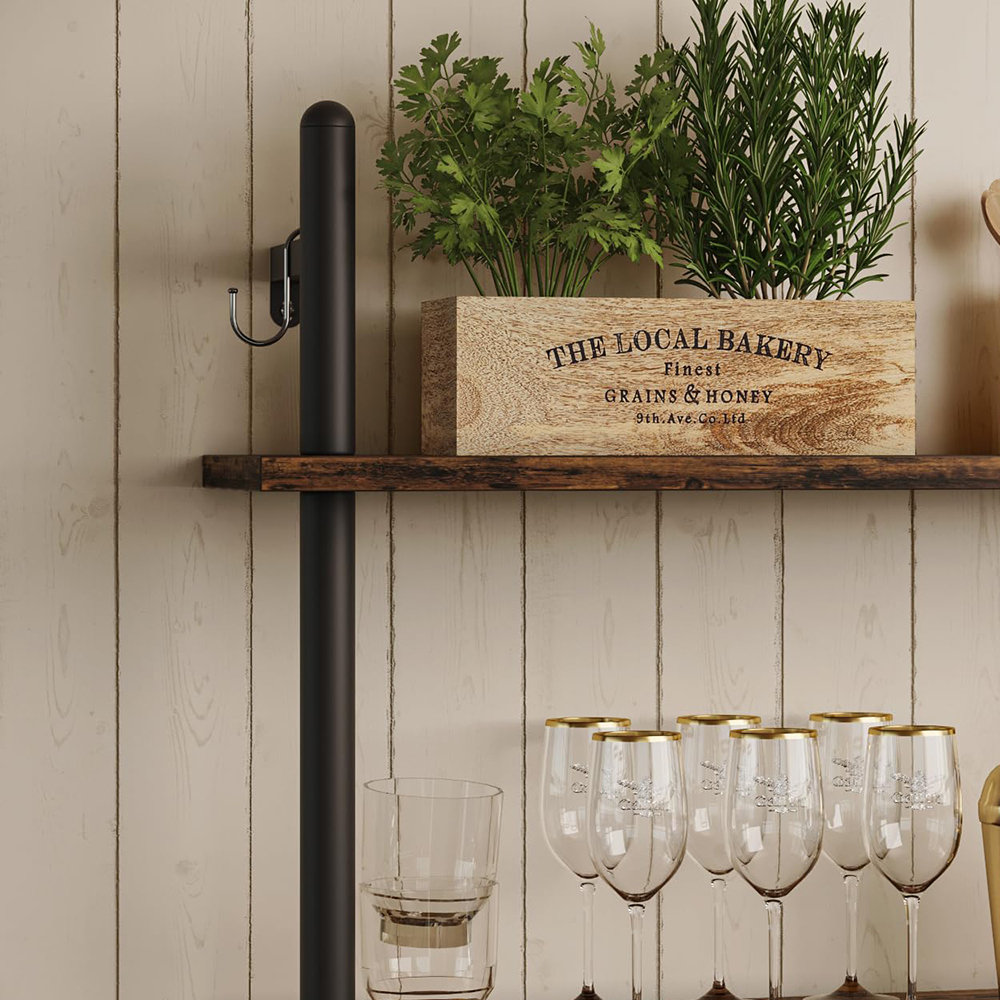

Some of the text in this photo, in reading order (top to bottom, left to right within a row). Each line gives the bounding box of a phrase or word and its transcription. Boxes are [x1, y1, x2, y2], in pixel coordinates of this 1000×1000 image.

[546, 328, 833, 371] THE LOCAL BAKERY
[664, 361, 721, 376] Finest
[604, 384, 773, 405] GRAINS & HONEY
